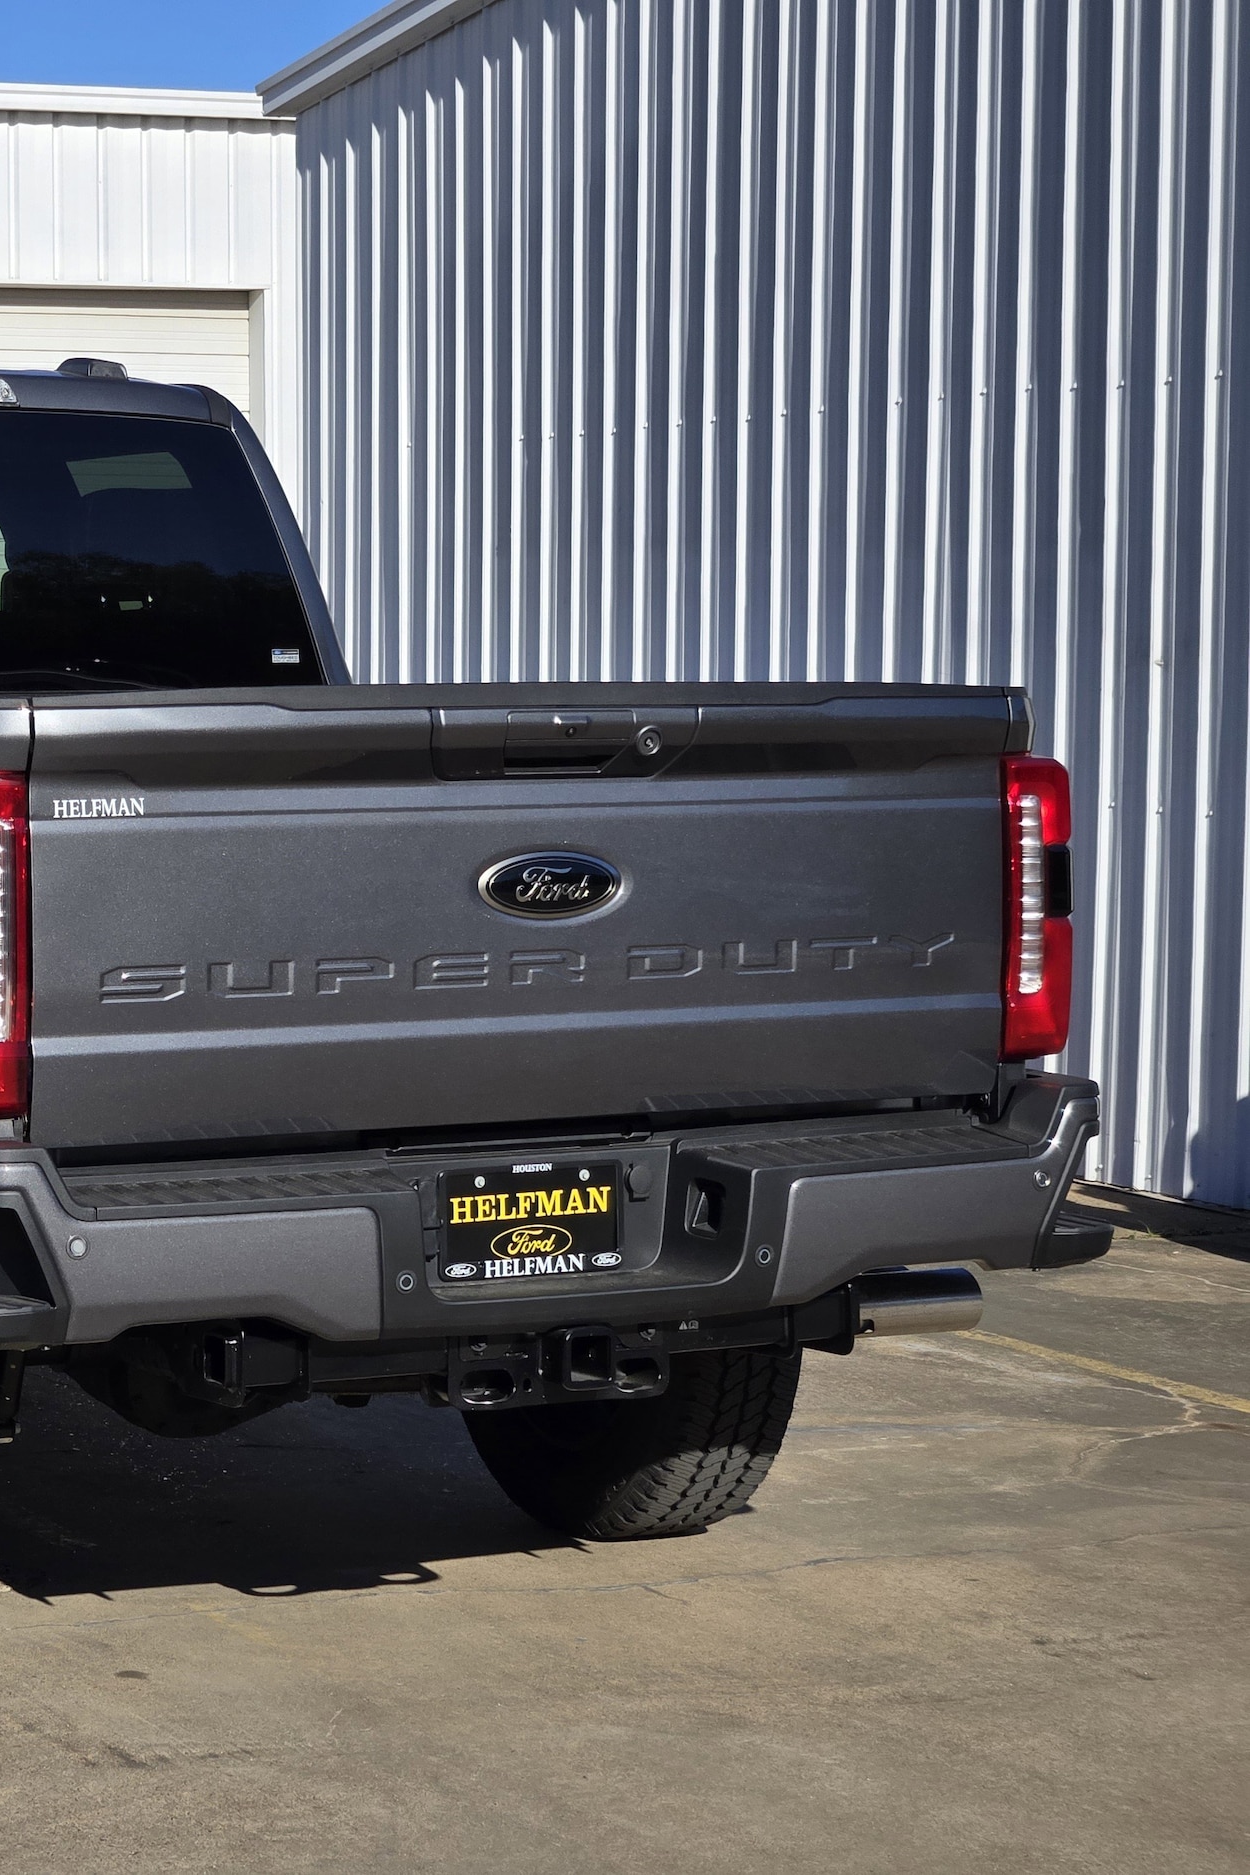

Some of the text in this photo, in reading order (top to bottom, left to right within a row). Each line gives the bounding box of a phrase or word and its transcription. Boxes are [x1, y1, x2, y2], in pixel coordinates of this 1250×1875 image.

[53, 797, 145, 818] HELFMAN
[516, 866, 590, 903] Ford
[99, 931, 955, 1004] SUPER DUTY
[512, 1162, 553, 1173] HOUSTON
[449, 1185, 612, 1224] HELFMAN
[507, 1229, 557, 1255] Ford
[483, 1253, 586, 1279] HELFMAN
